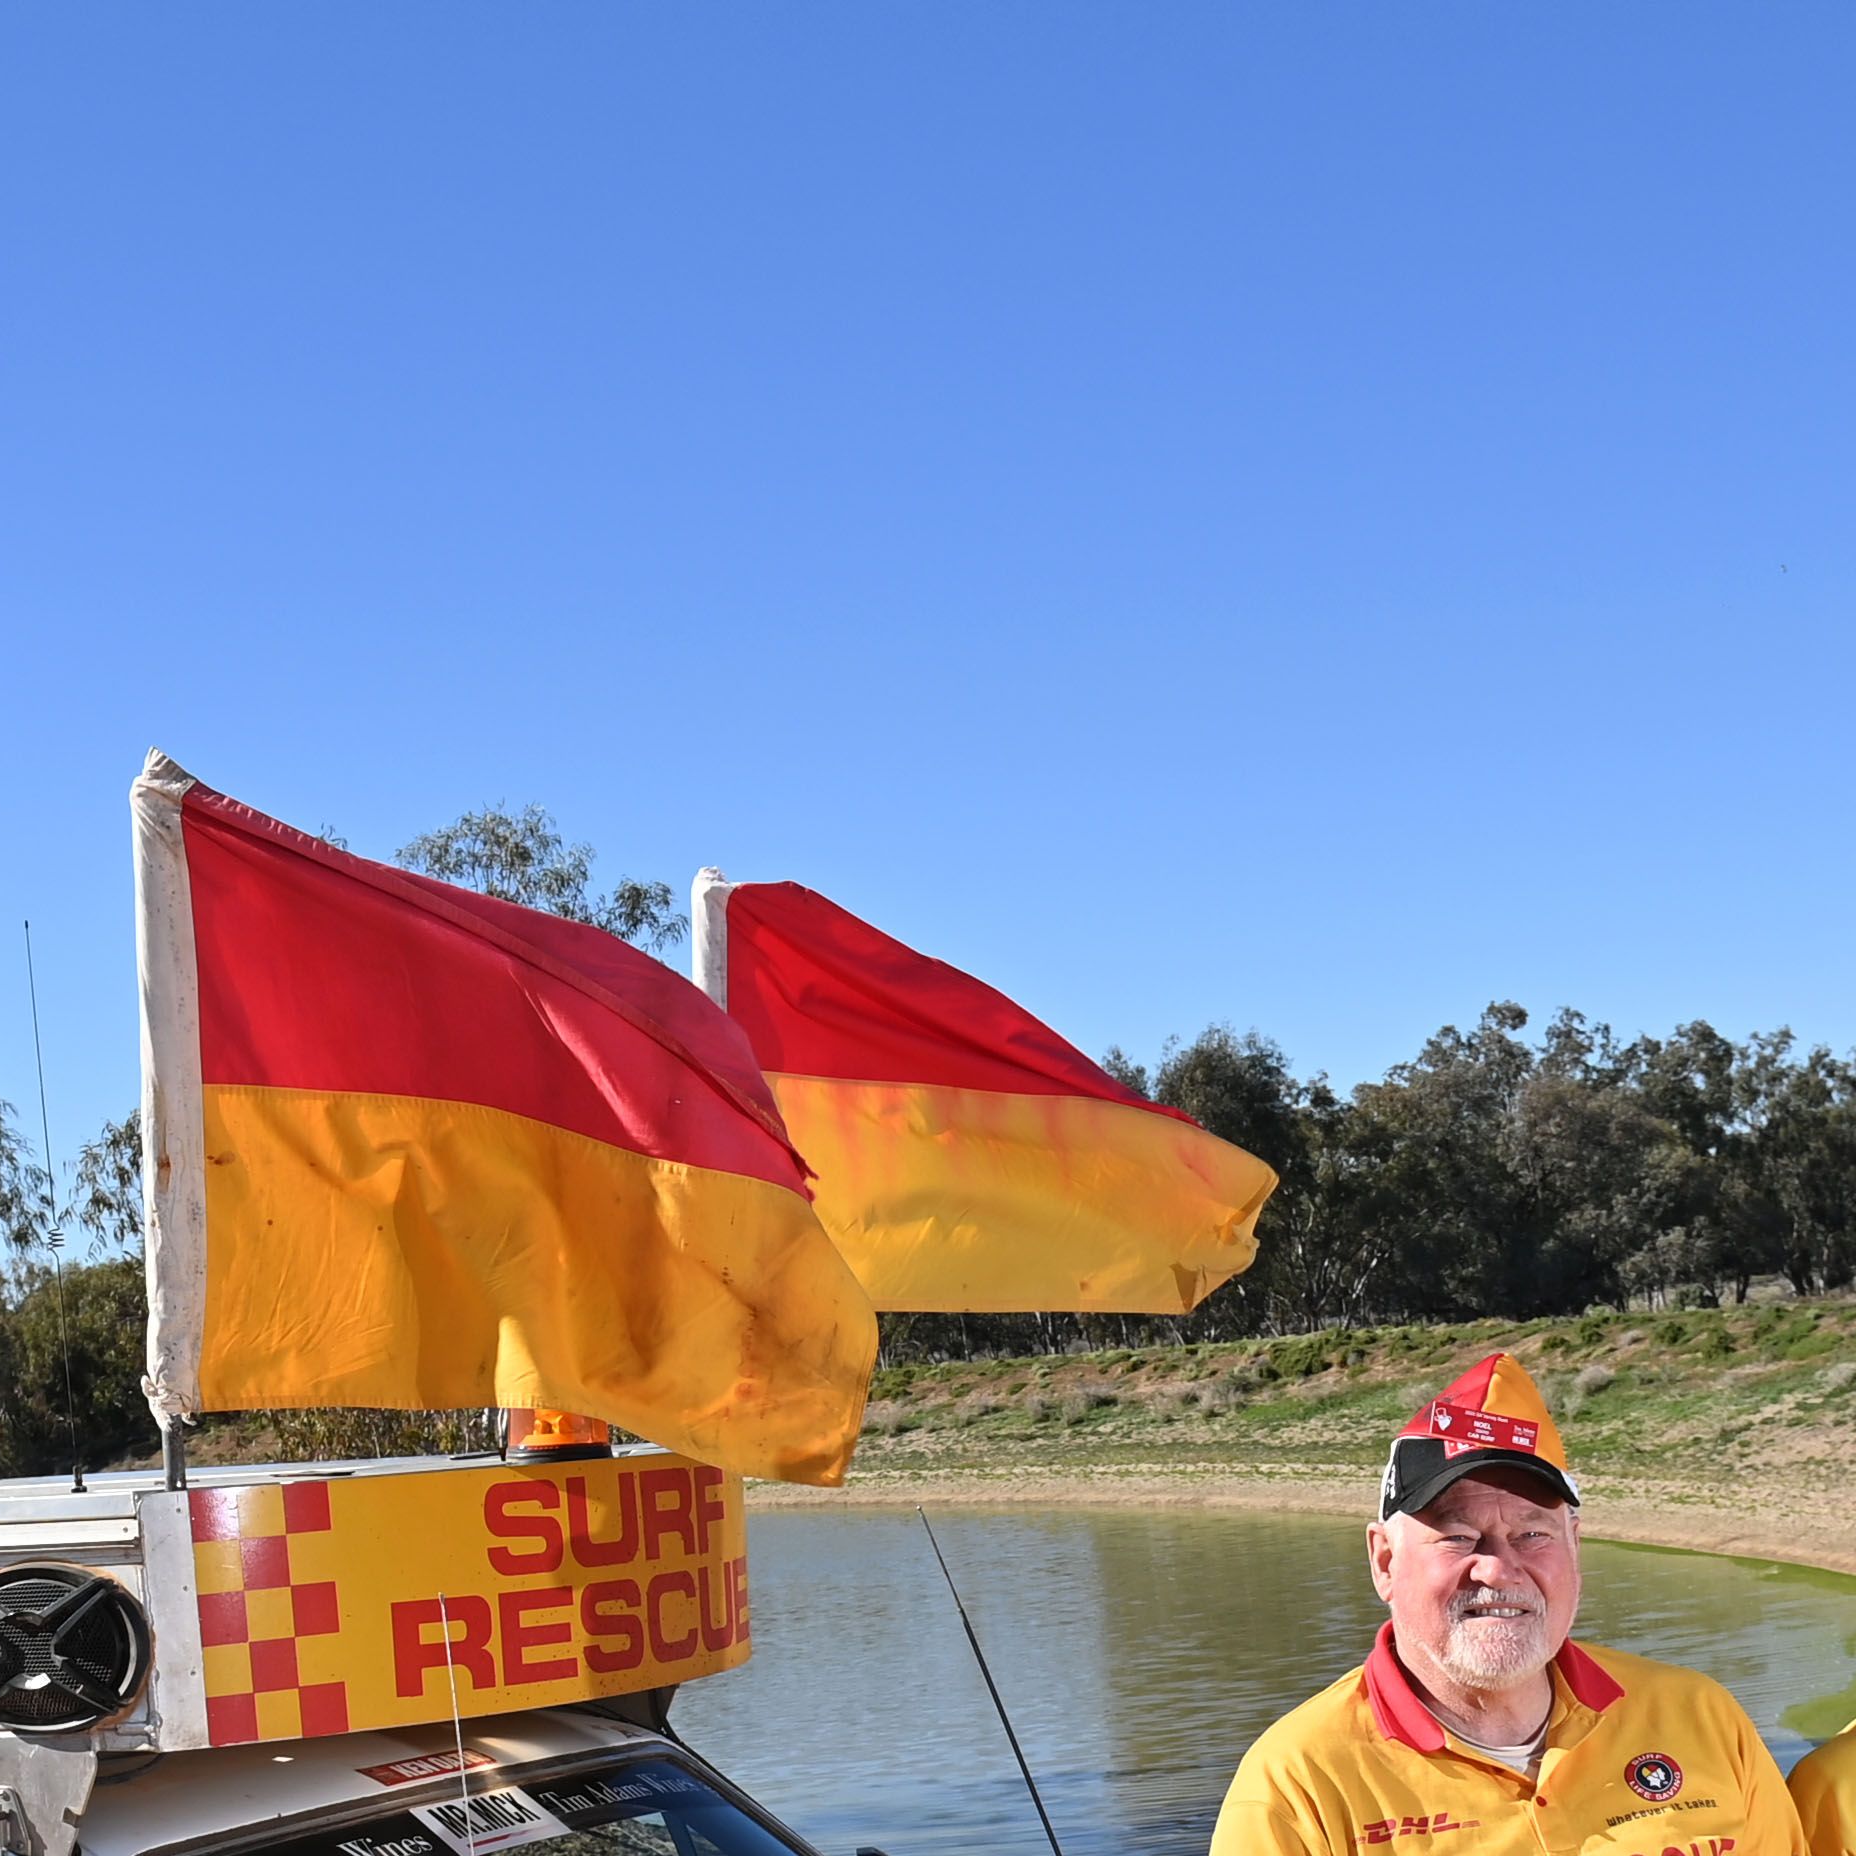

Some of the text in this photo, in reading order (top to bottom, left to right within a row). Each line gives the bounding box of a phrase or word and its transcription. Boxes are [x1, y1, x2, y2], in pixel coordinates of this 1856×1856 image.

[483, 1466, 723, 1578] SURF
[391, 1554, 750, 1698] RESCUE
[1632, 1754, 1663, 1766] SURF
[540, 1790, 594, 1814] Tim
[592, 1781, 653, 1806] Adams
[1629, 1771, 1681, 1800] LIFE SAVING
[427, 1791, 541, 1839] MR.MICK
[1359, 1813, 1464, 1845] DHL
[1606, 1807, 1667, 1827] Whatever
[1670, 1803, 1683, 1811] it
